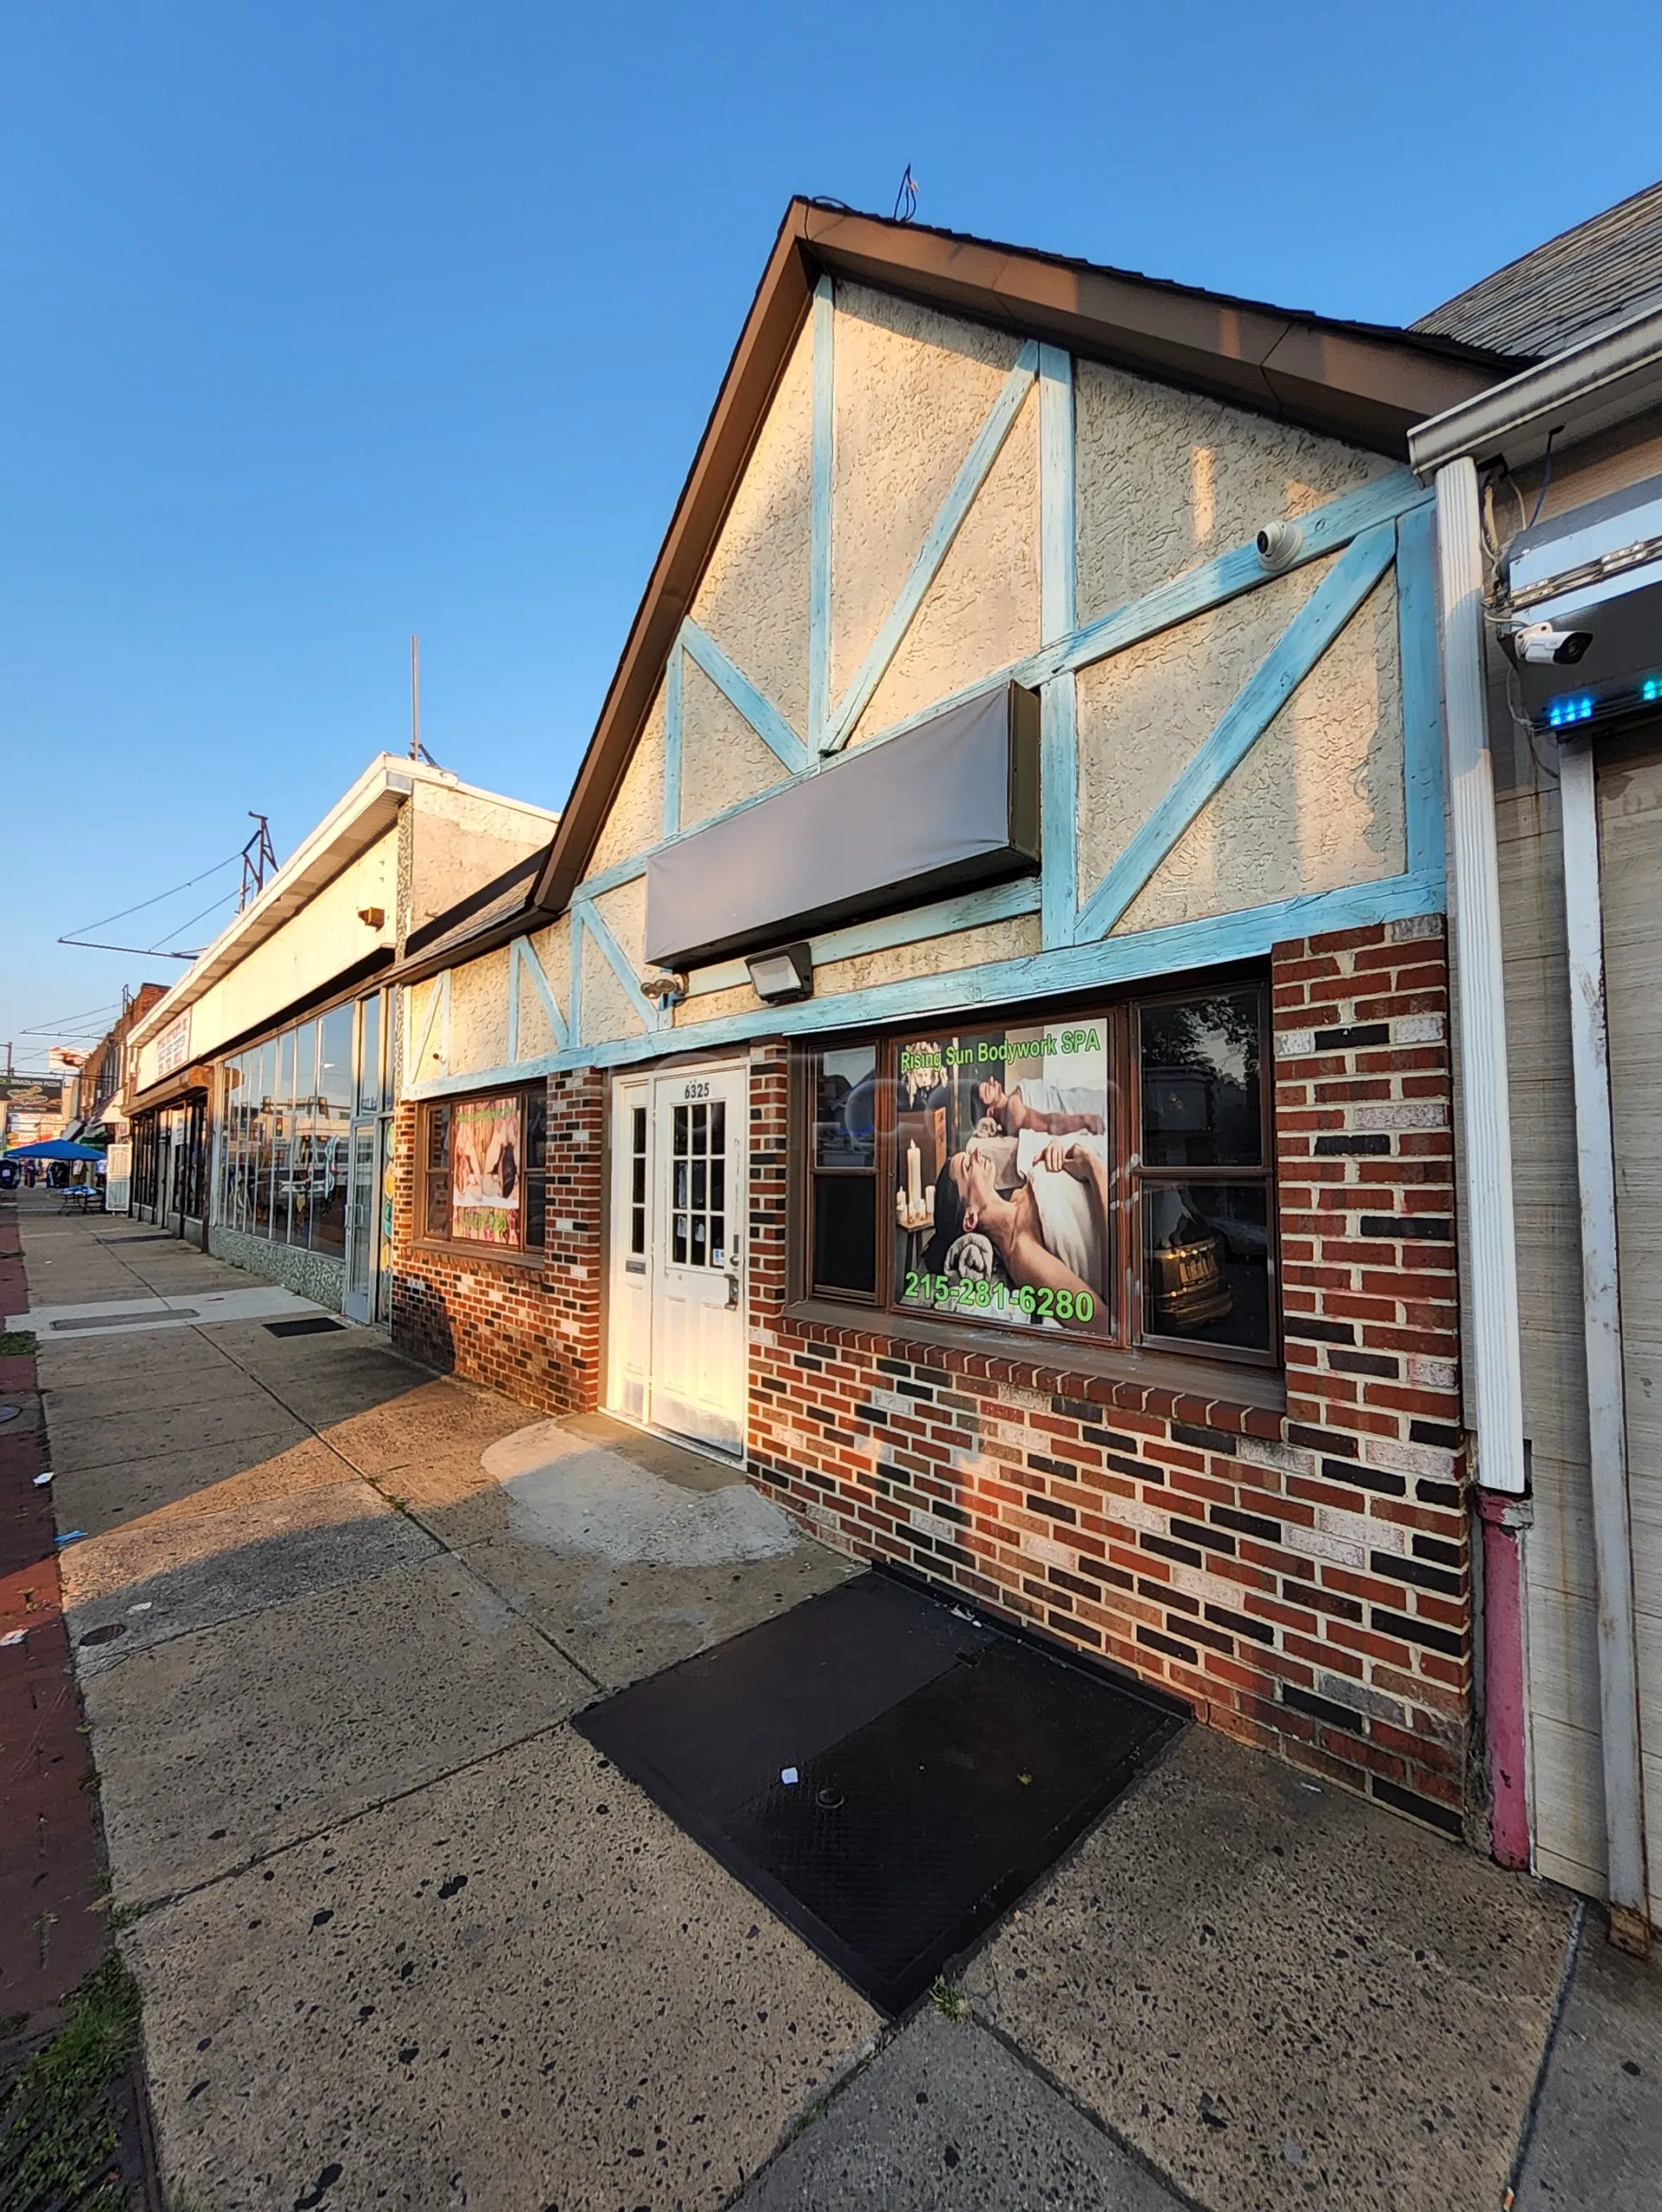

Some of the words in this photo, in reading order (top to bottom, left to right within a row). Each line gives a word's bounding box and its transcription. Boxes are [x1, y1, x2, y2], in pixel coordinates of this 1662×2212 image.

[901, 1050, 942, 1071] Rising
[946, 1046, 973, 1065] Sun
[977, 1033, 1056, 1065] Bodywork
[1060, 1028, 1100, 1054] SPA
[685, 1082, 710, 1099] 6325
[905, 1271, 1094, 1323] 215-281-6280
